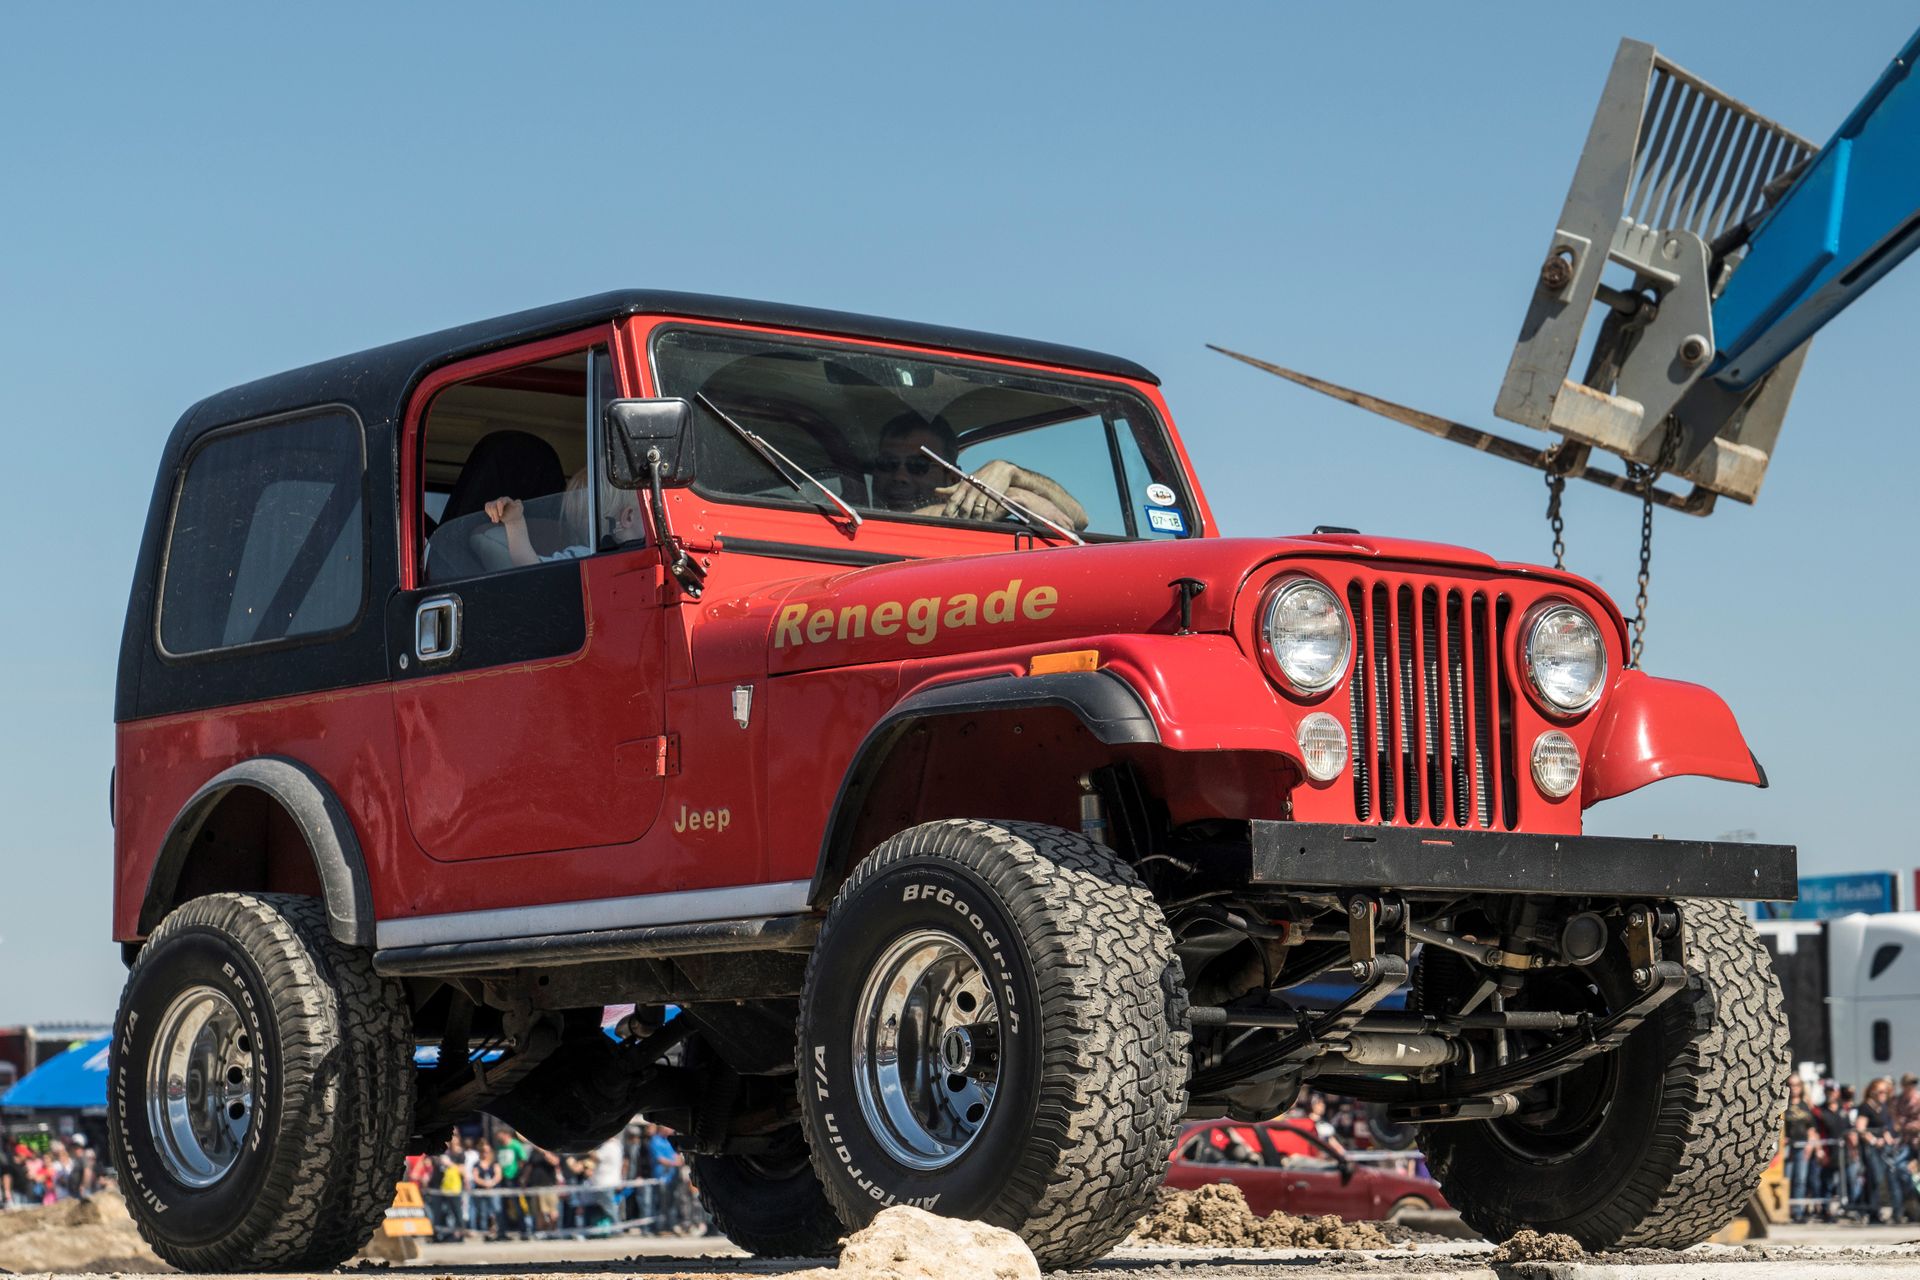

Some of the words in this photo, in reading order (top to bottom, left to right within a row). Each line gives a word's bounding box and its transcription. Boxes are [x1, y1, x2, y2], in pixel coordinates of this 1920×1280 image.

[774, 579, 1058, 648] Renegade
[674, 805, 731, 833] Jeep
[902, 883, 1020, 1035] BFGoodrich
[120, 1009, 140, 1055] T/A
[221, 961, 269, 1152] BFGoodrich
[814, 1045, 828, 1102] T/A
[116, 1066, 169, 1214] All-Terrain
